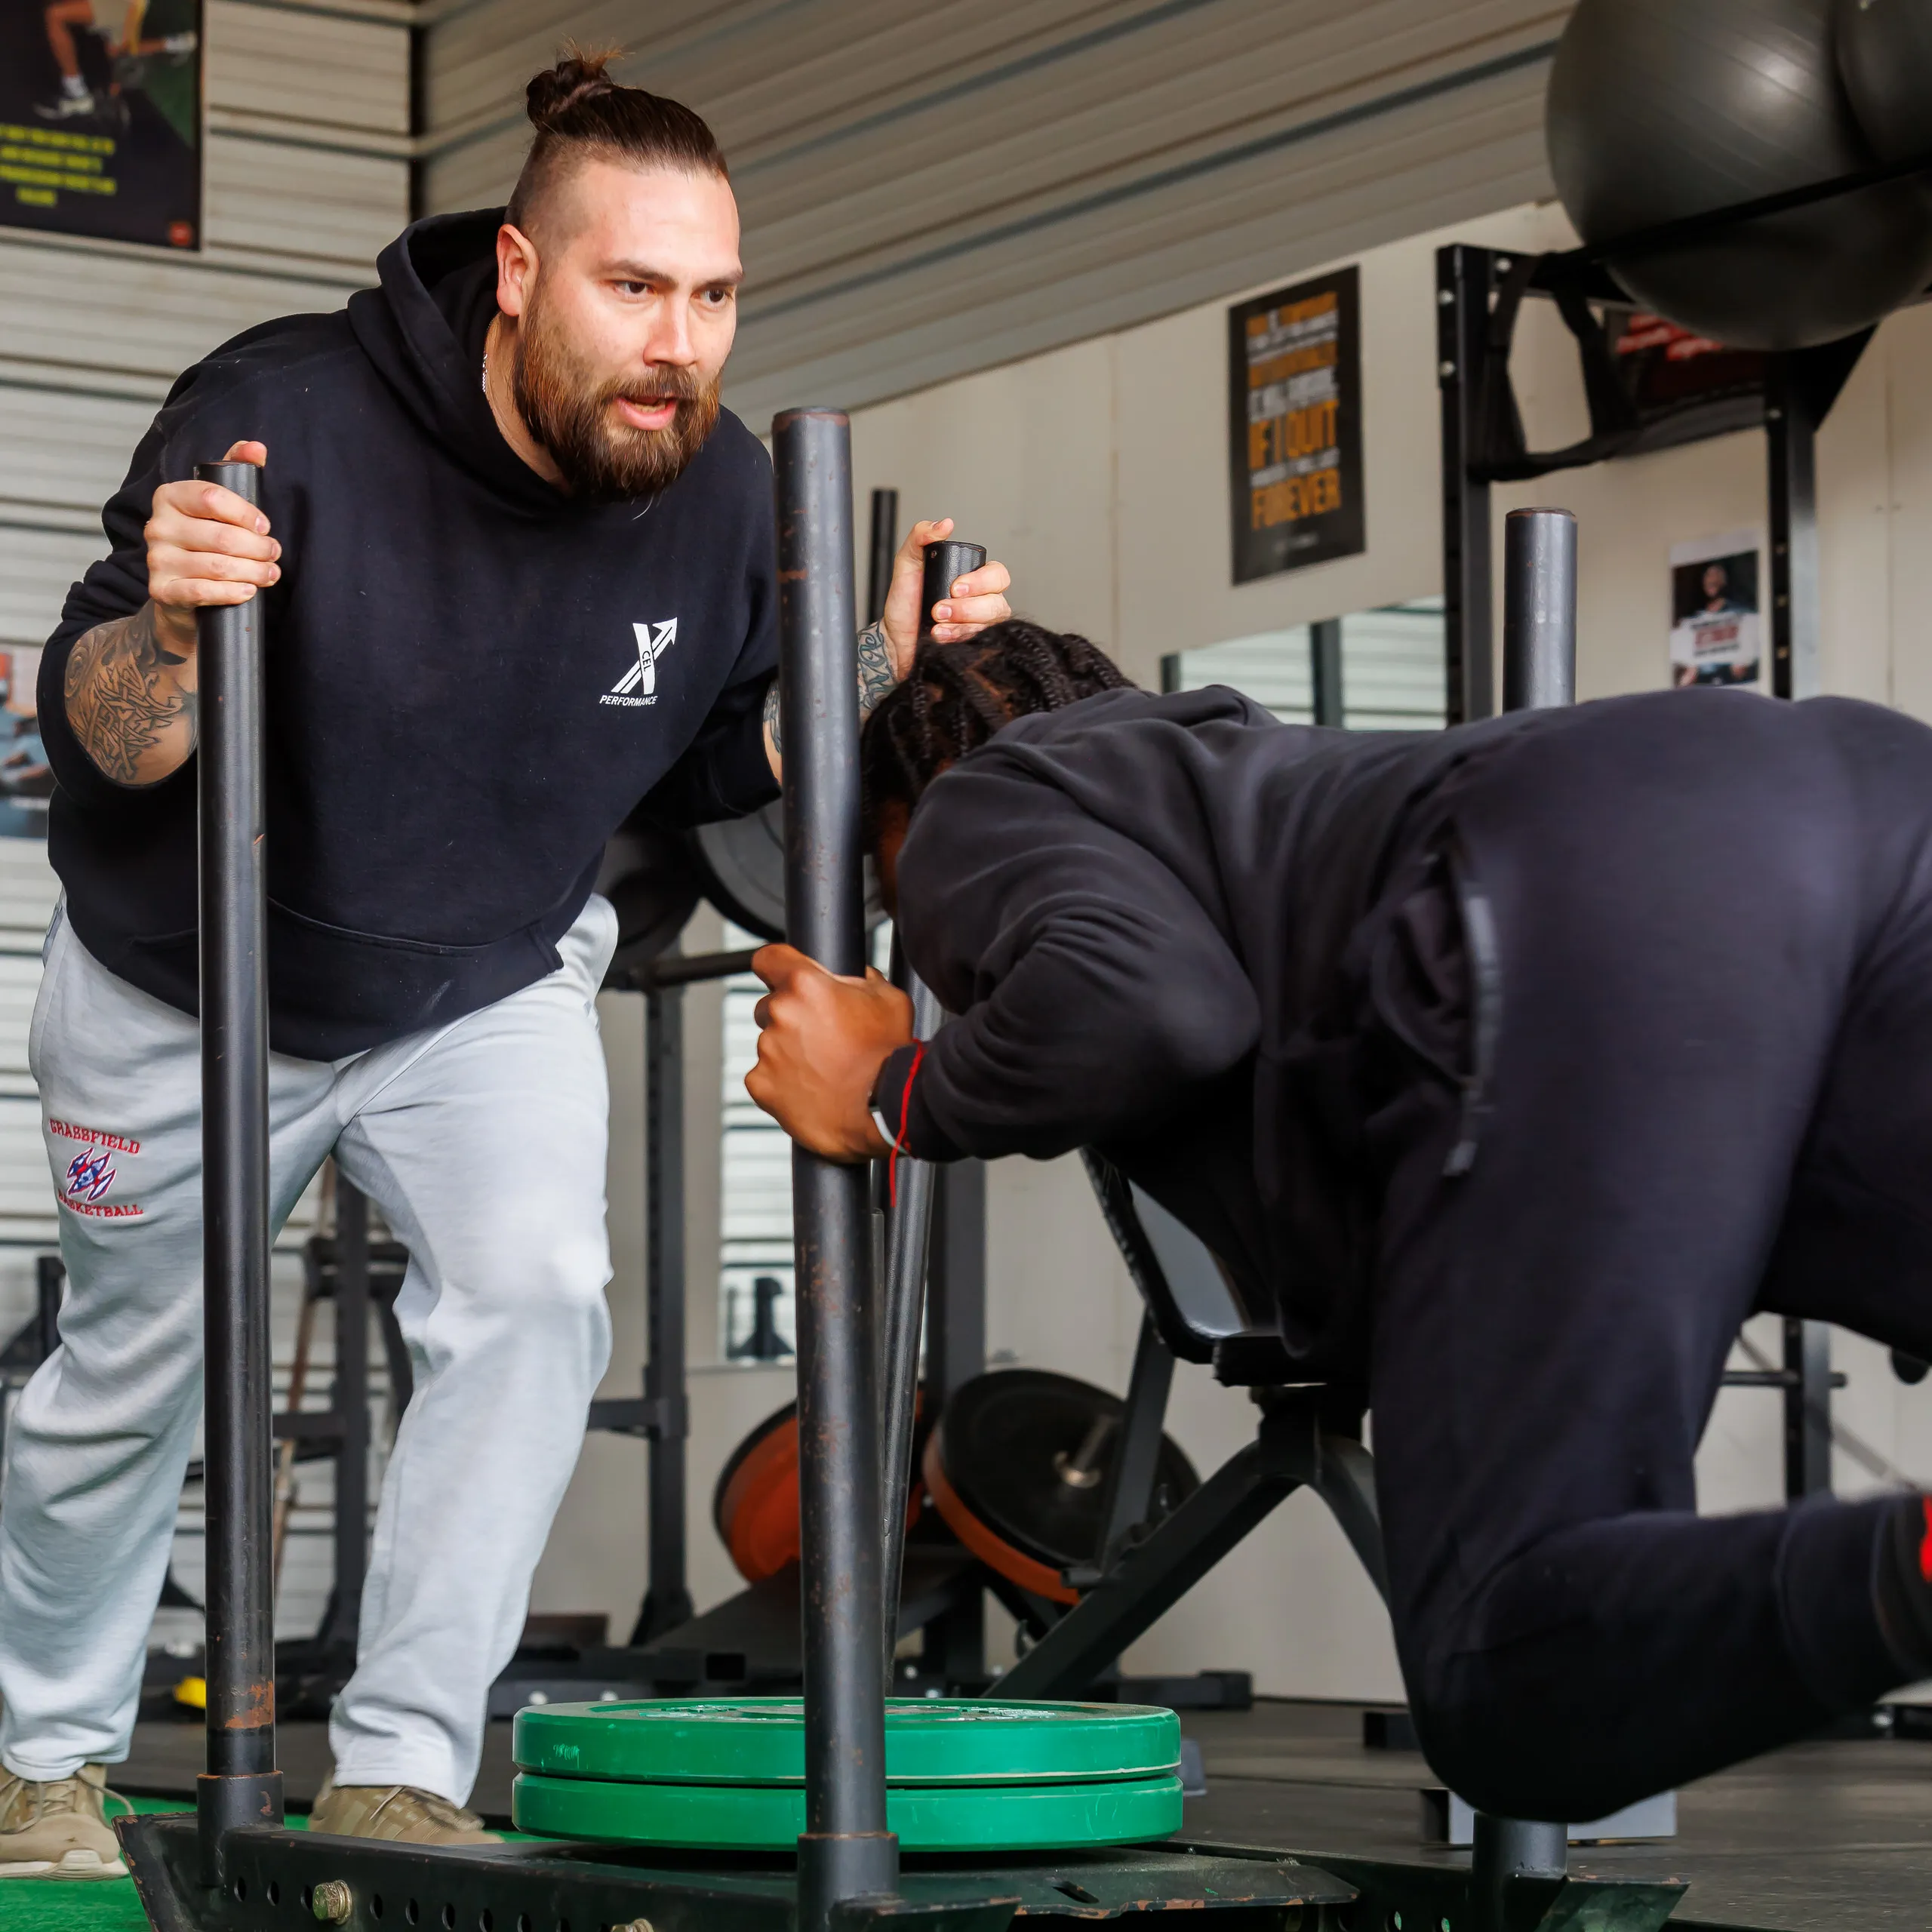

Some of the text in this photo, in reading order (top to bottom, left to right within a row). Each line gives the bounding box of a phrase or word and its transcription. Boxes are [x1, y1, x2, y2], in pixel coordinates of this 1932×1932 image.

[1284, 398, 1340, 459] QUIT
[1251, 467, 1341, 531] FOREVER
[599, 695, 658, 706] PERFORMANCE
[49, 1118, 141, 1155] GRASSFIELD
